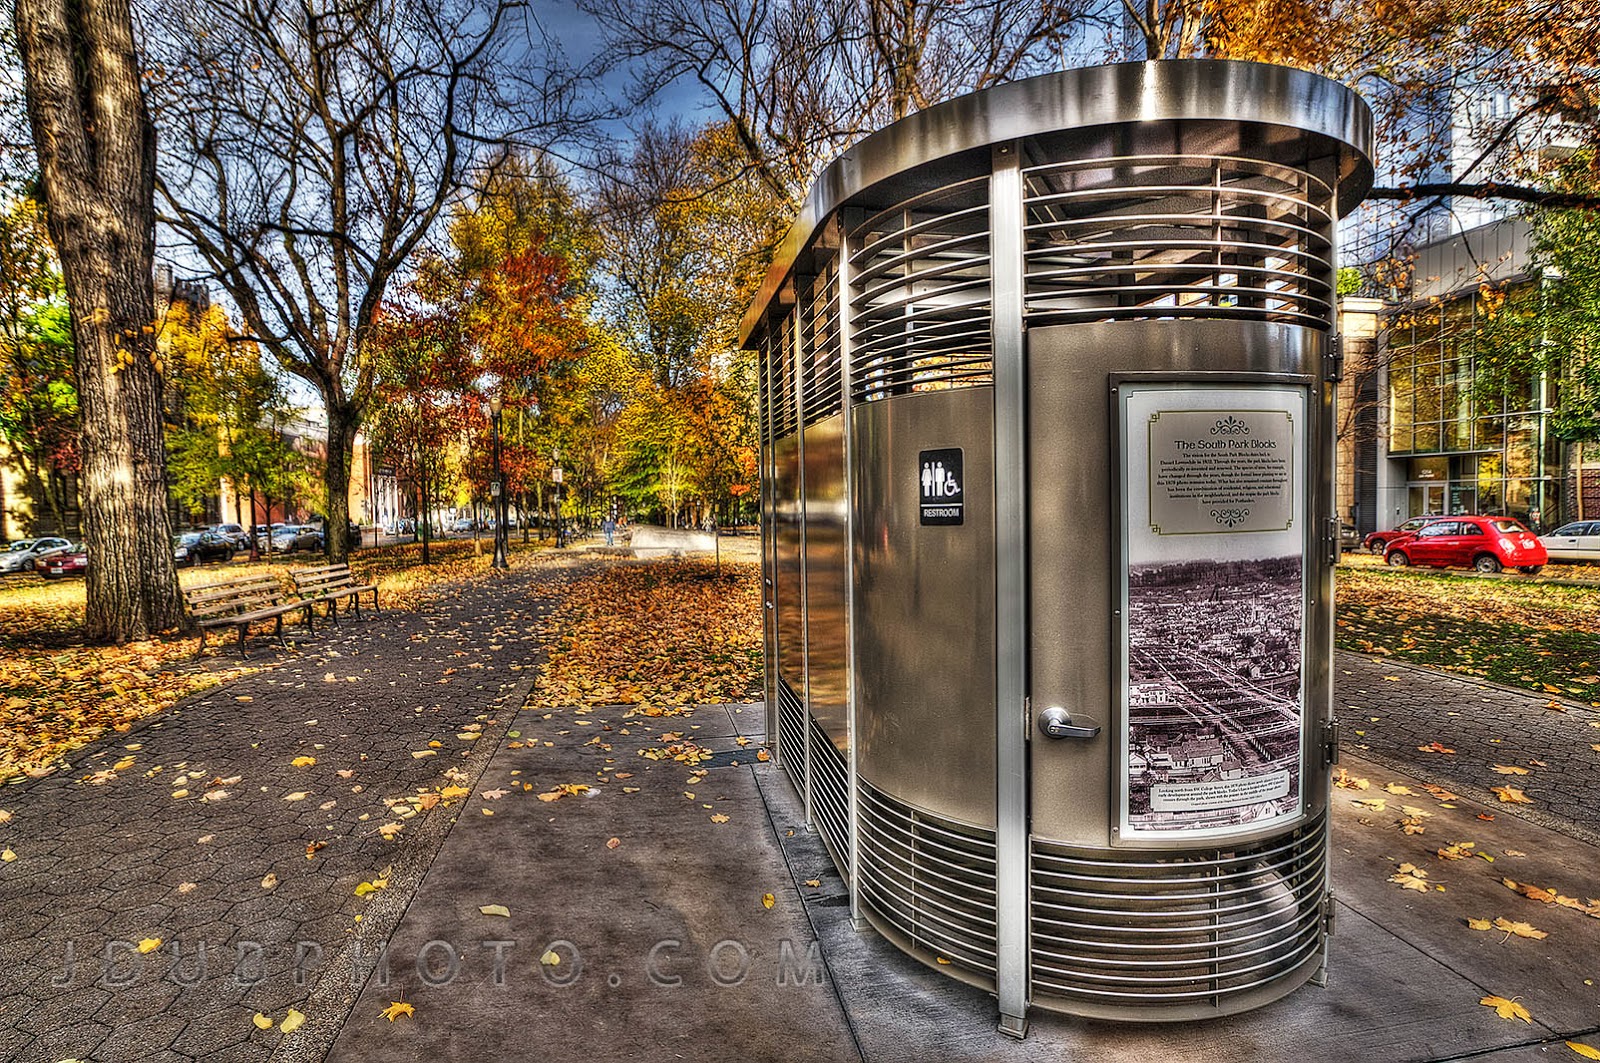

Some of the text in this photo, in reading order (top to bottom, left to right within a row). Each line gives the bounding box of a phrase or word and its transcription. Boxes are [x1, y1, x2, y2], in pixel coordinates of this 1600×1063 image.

[1174, 440, 1276, 450] The South Park Blocks
[924, 508, 960, 517] RESTROOM
